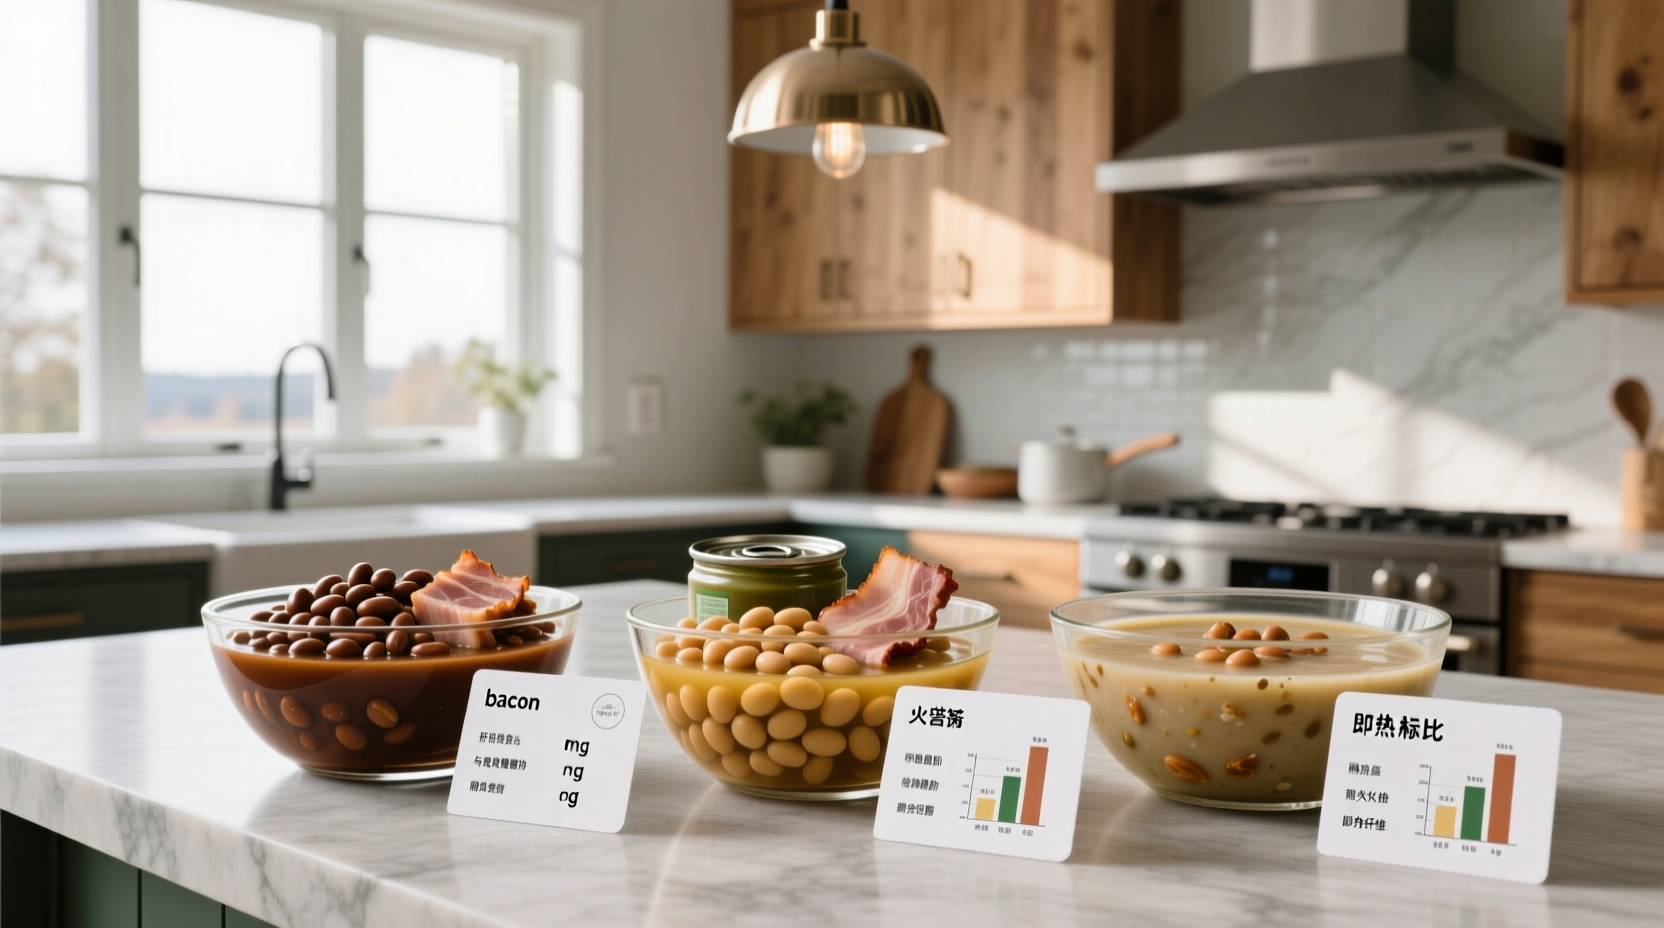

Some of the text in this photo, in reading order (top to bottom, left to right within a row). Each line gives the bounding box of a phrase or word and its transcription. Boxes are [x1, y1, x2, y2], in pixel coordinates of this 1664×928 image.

[485, 688, 540, 711] bacon
[564, 739, 590, 757] mg
[562, 766, 584, 782] ng
